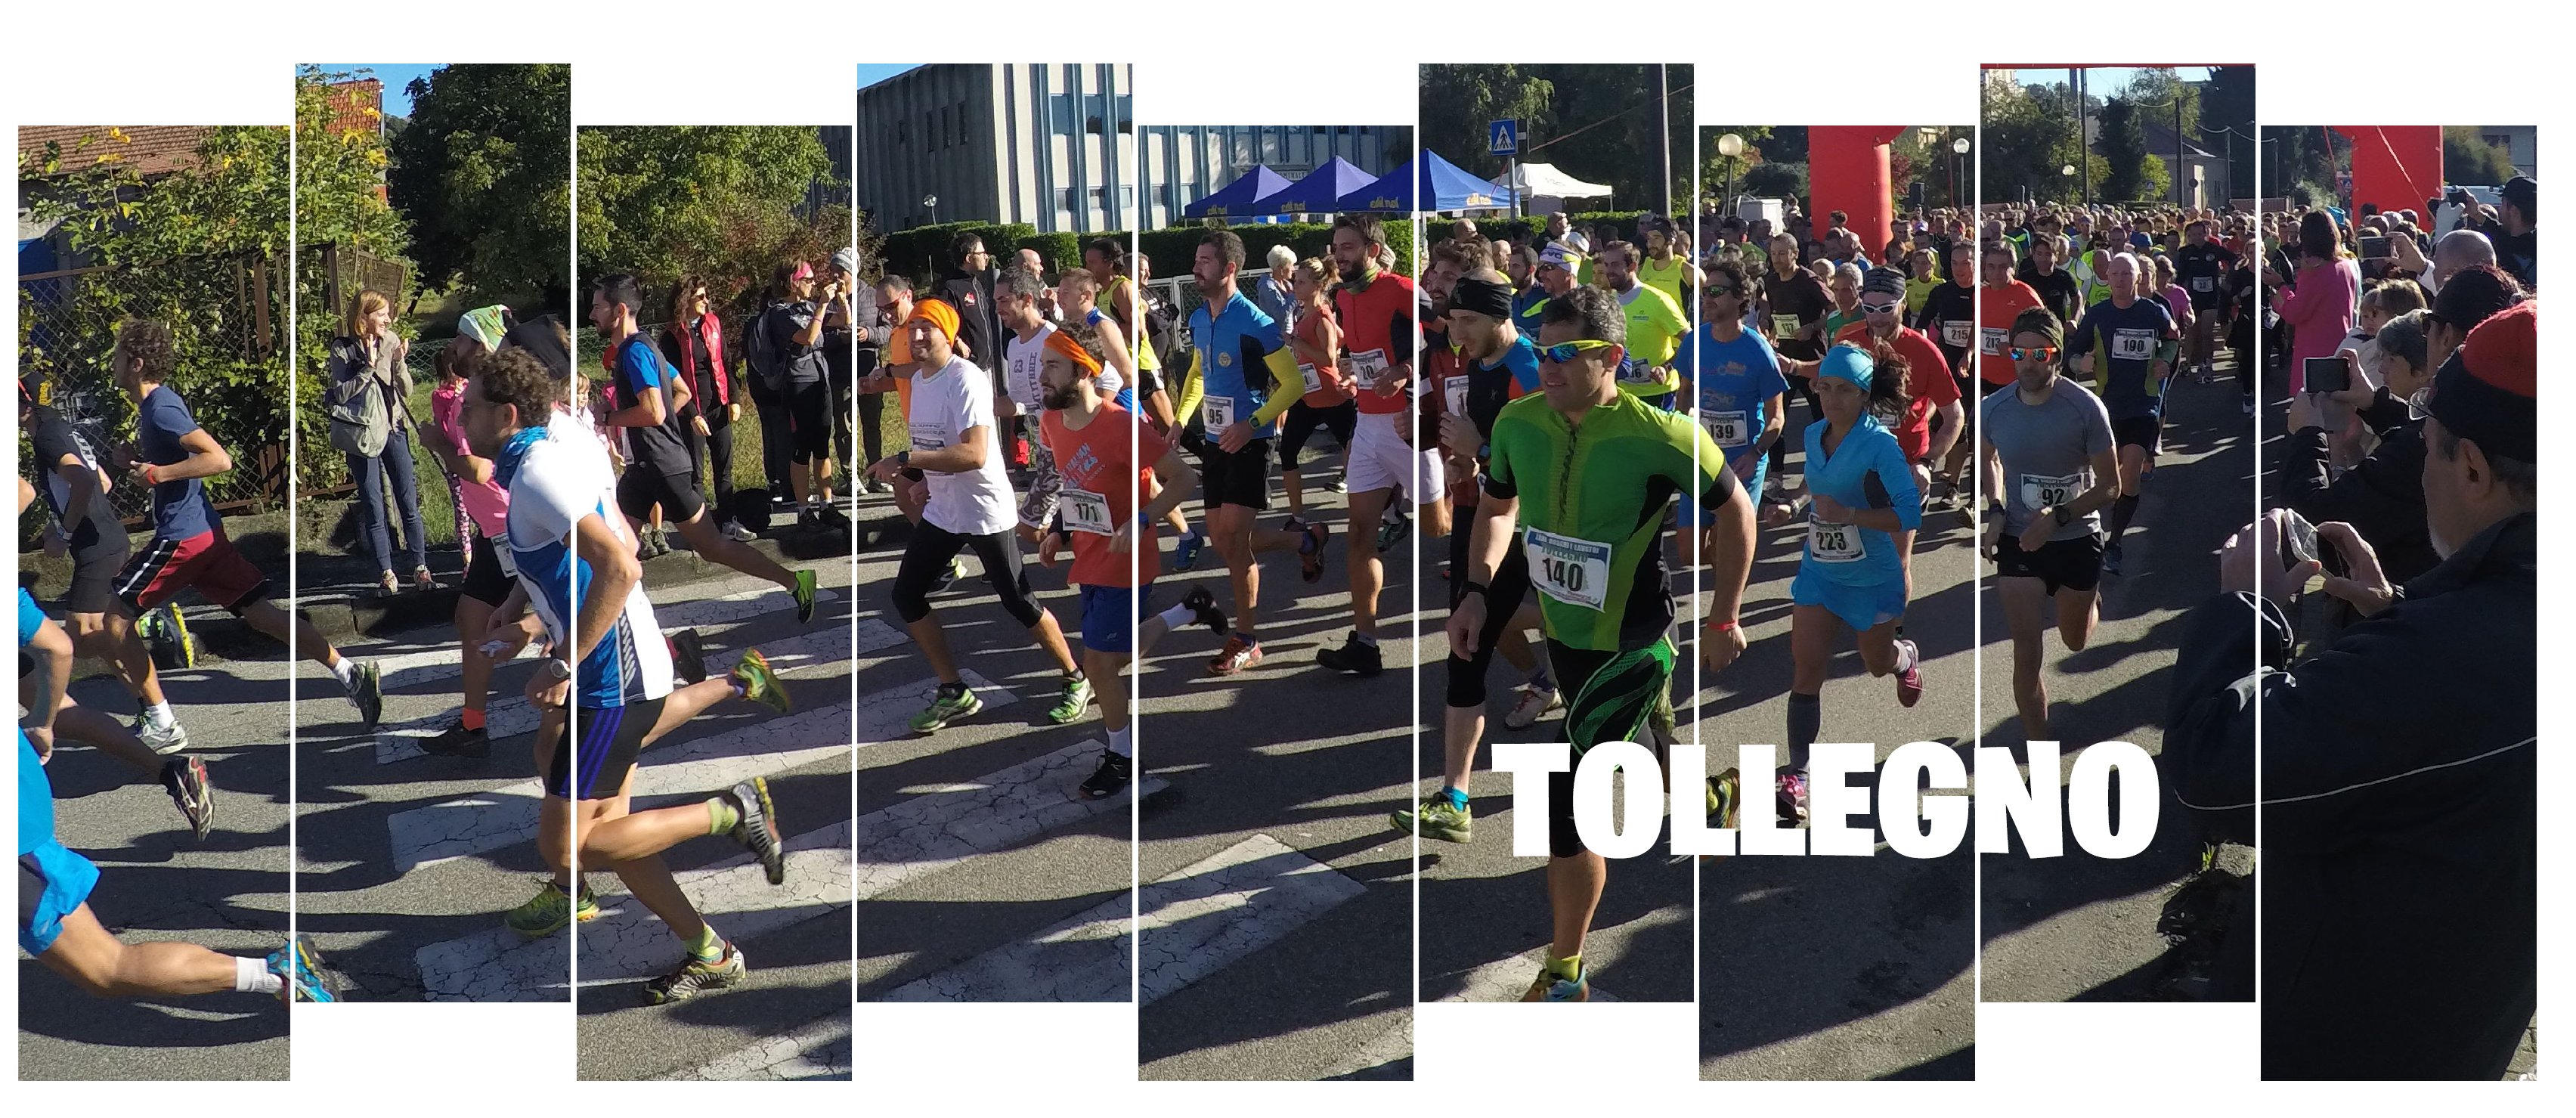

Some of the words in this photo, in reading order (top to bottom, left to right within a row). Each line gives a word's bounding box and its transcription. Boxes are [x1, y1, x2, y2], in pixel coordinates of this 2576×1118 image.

[1951, 329, 1968, 340] 215
[2123, 339, 2144, 352] 190
[1209, 408, 1223, 425] 95
[1709, 424, 1734, 439] 139
[2042, 488, 2065, 506] 92
[1075, 503, 1098, 522] 171
[1816, 531, 1847, 551] 223
[1542, 557, 1583, 592] 140
